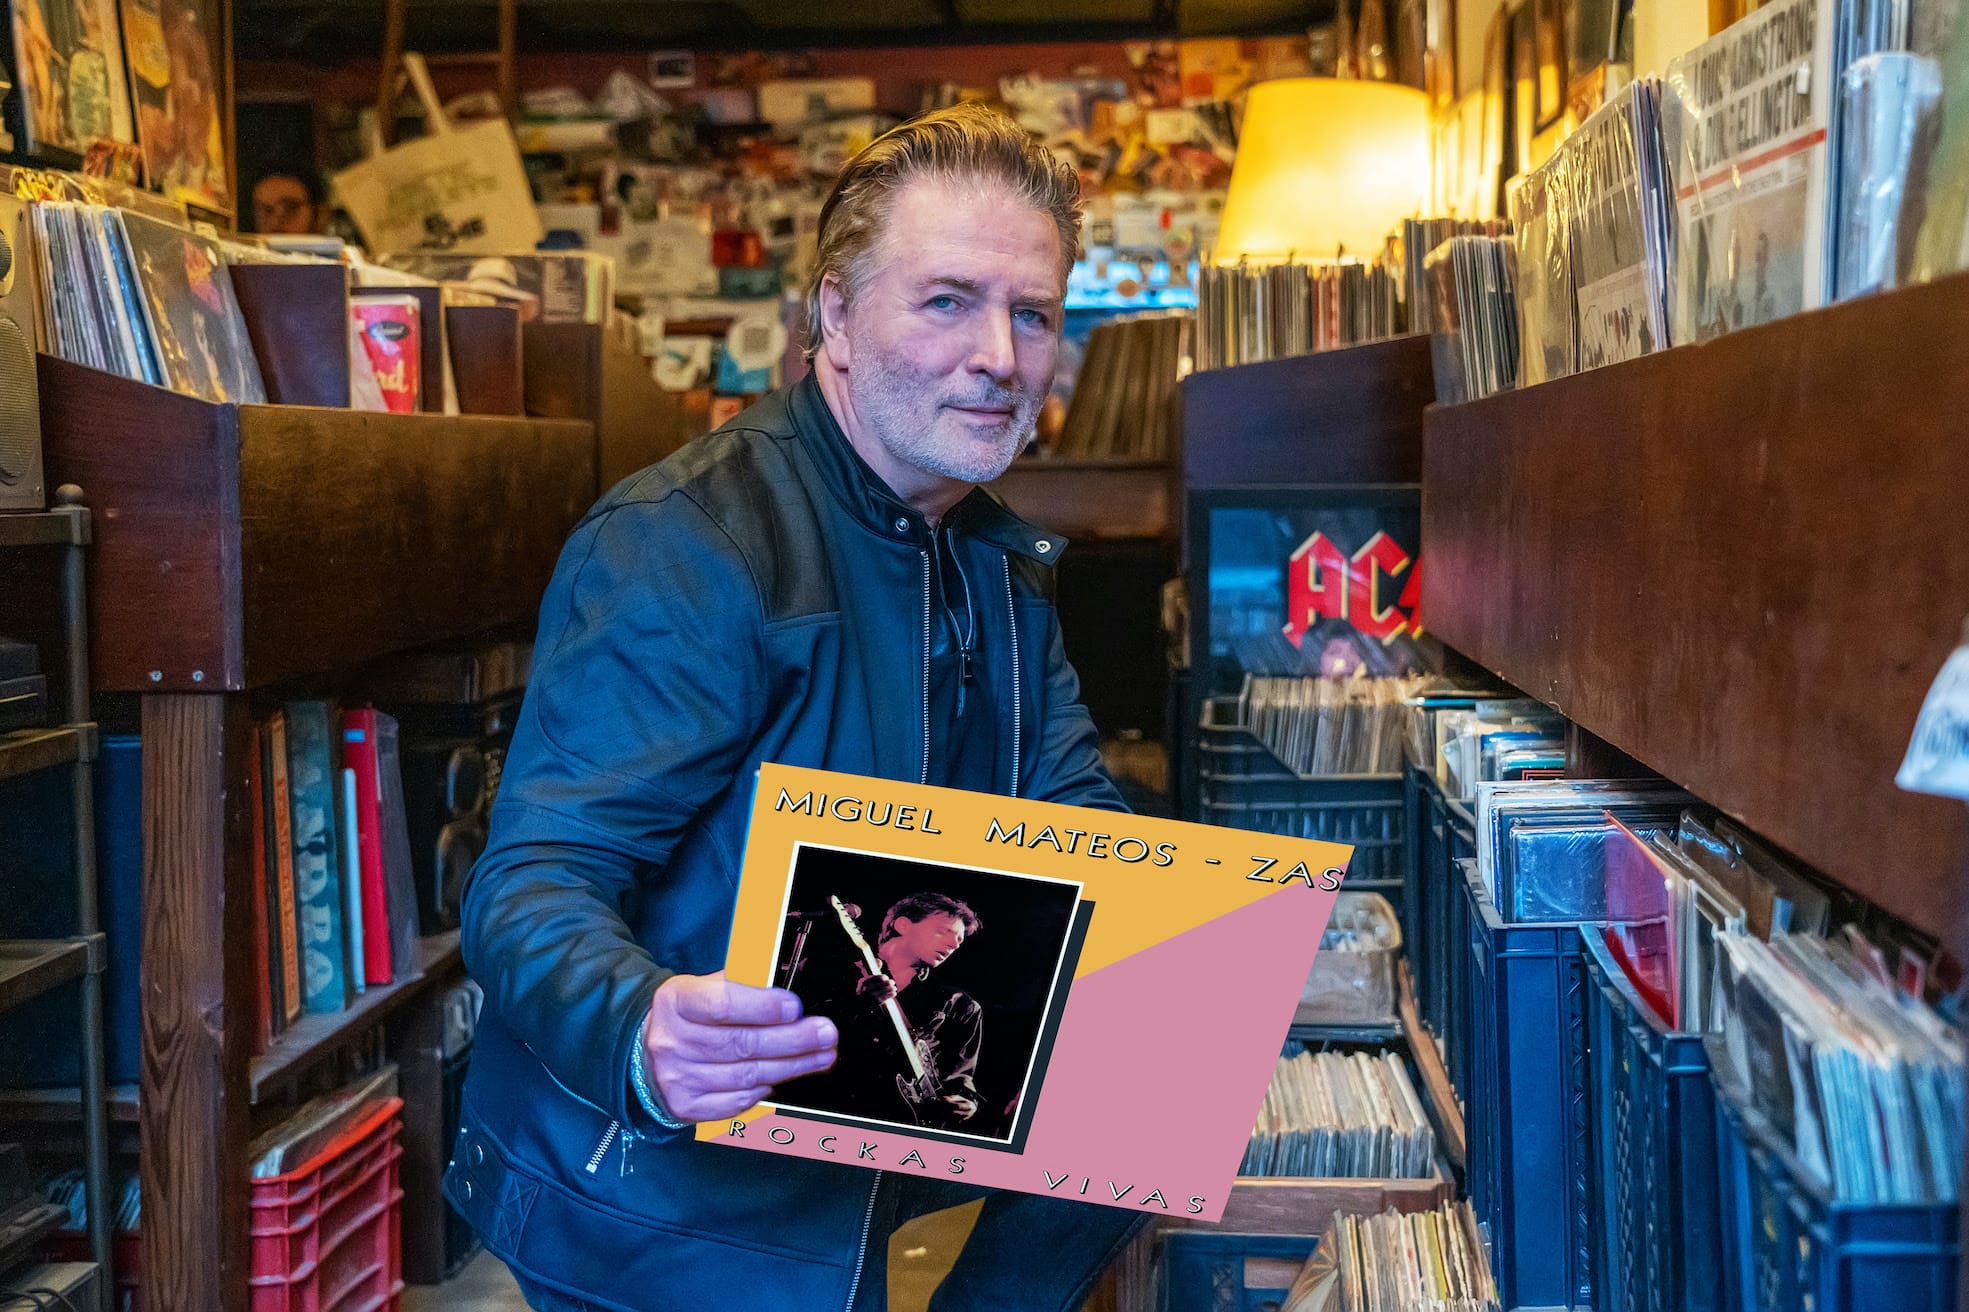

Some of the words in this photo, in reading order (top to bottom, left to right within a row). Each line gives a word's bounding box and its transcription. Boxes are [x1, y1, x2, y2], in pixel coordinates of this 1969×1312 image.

[774, 787, 942, 835] MIGUEL
[984, 816, 1178, 867] MATEOS
[1204, 857, 1222, 866] -
[1245, 854, 1345, 892] ZAS
[729, 1119, 967, 1174] ROCKAS
[1043, 1170, 1206, 1214] VIVAS
